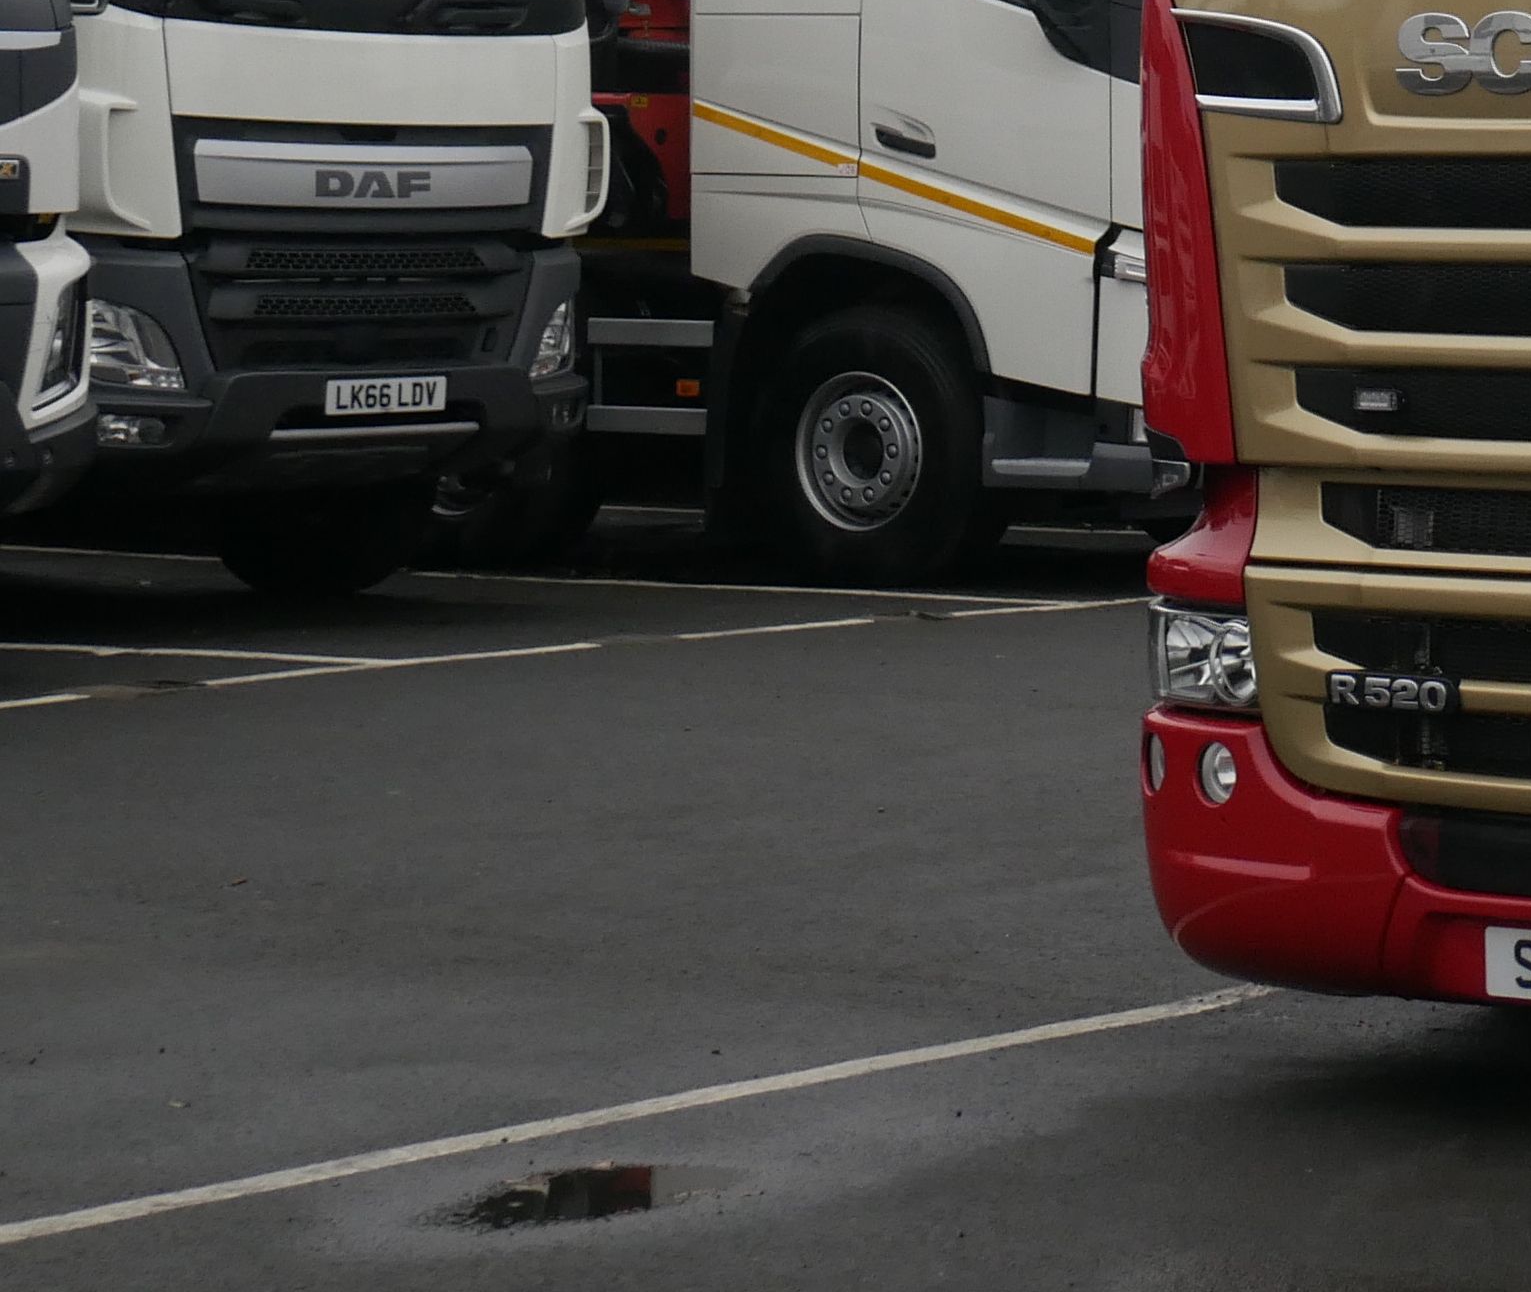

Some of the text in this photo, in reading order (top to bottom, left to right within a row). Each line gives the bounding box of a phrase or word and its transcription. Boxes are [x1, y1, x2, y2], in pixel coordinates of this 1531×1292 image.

[315, 170, 431, 198] DAF
[336, 381, 437, 409] LK66 LDV
